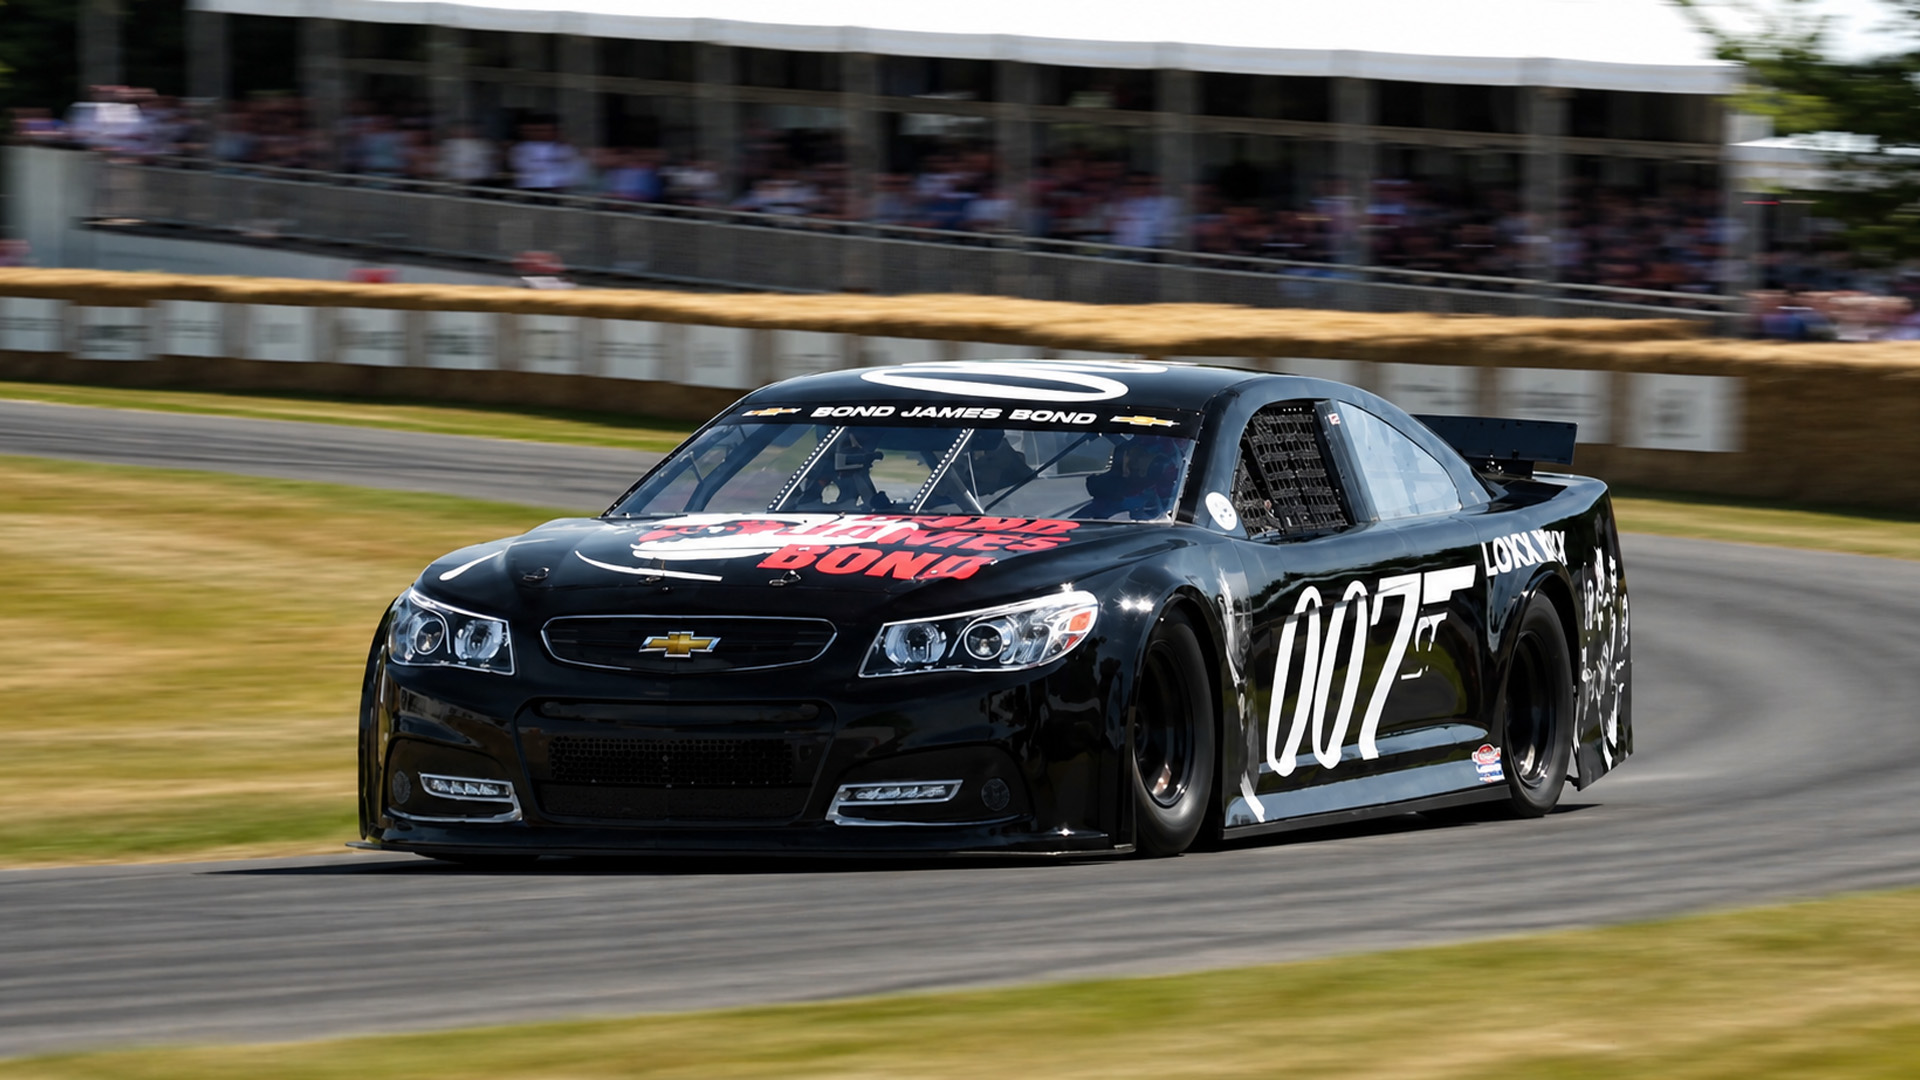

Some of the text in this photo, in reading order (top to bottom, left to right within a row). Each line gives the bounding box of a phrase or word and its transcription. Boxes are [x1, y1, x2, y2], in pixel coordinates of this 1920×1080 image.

[811, 406, 1097, 424] BOND JAMES BOND
[773, 523, 1071, 551] JAMES
[1481, 532, 1544, 577] LOXX
[757, 544, 996, 580] BOND
[1266, 572, 1422, 777] 007
